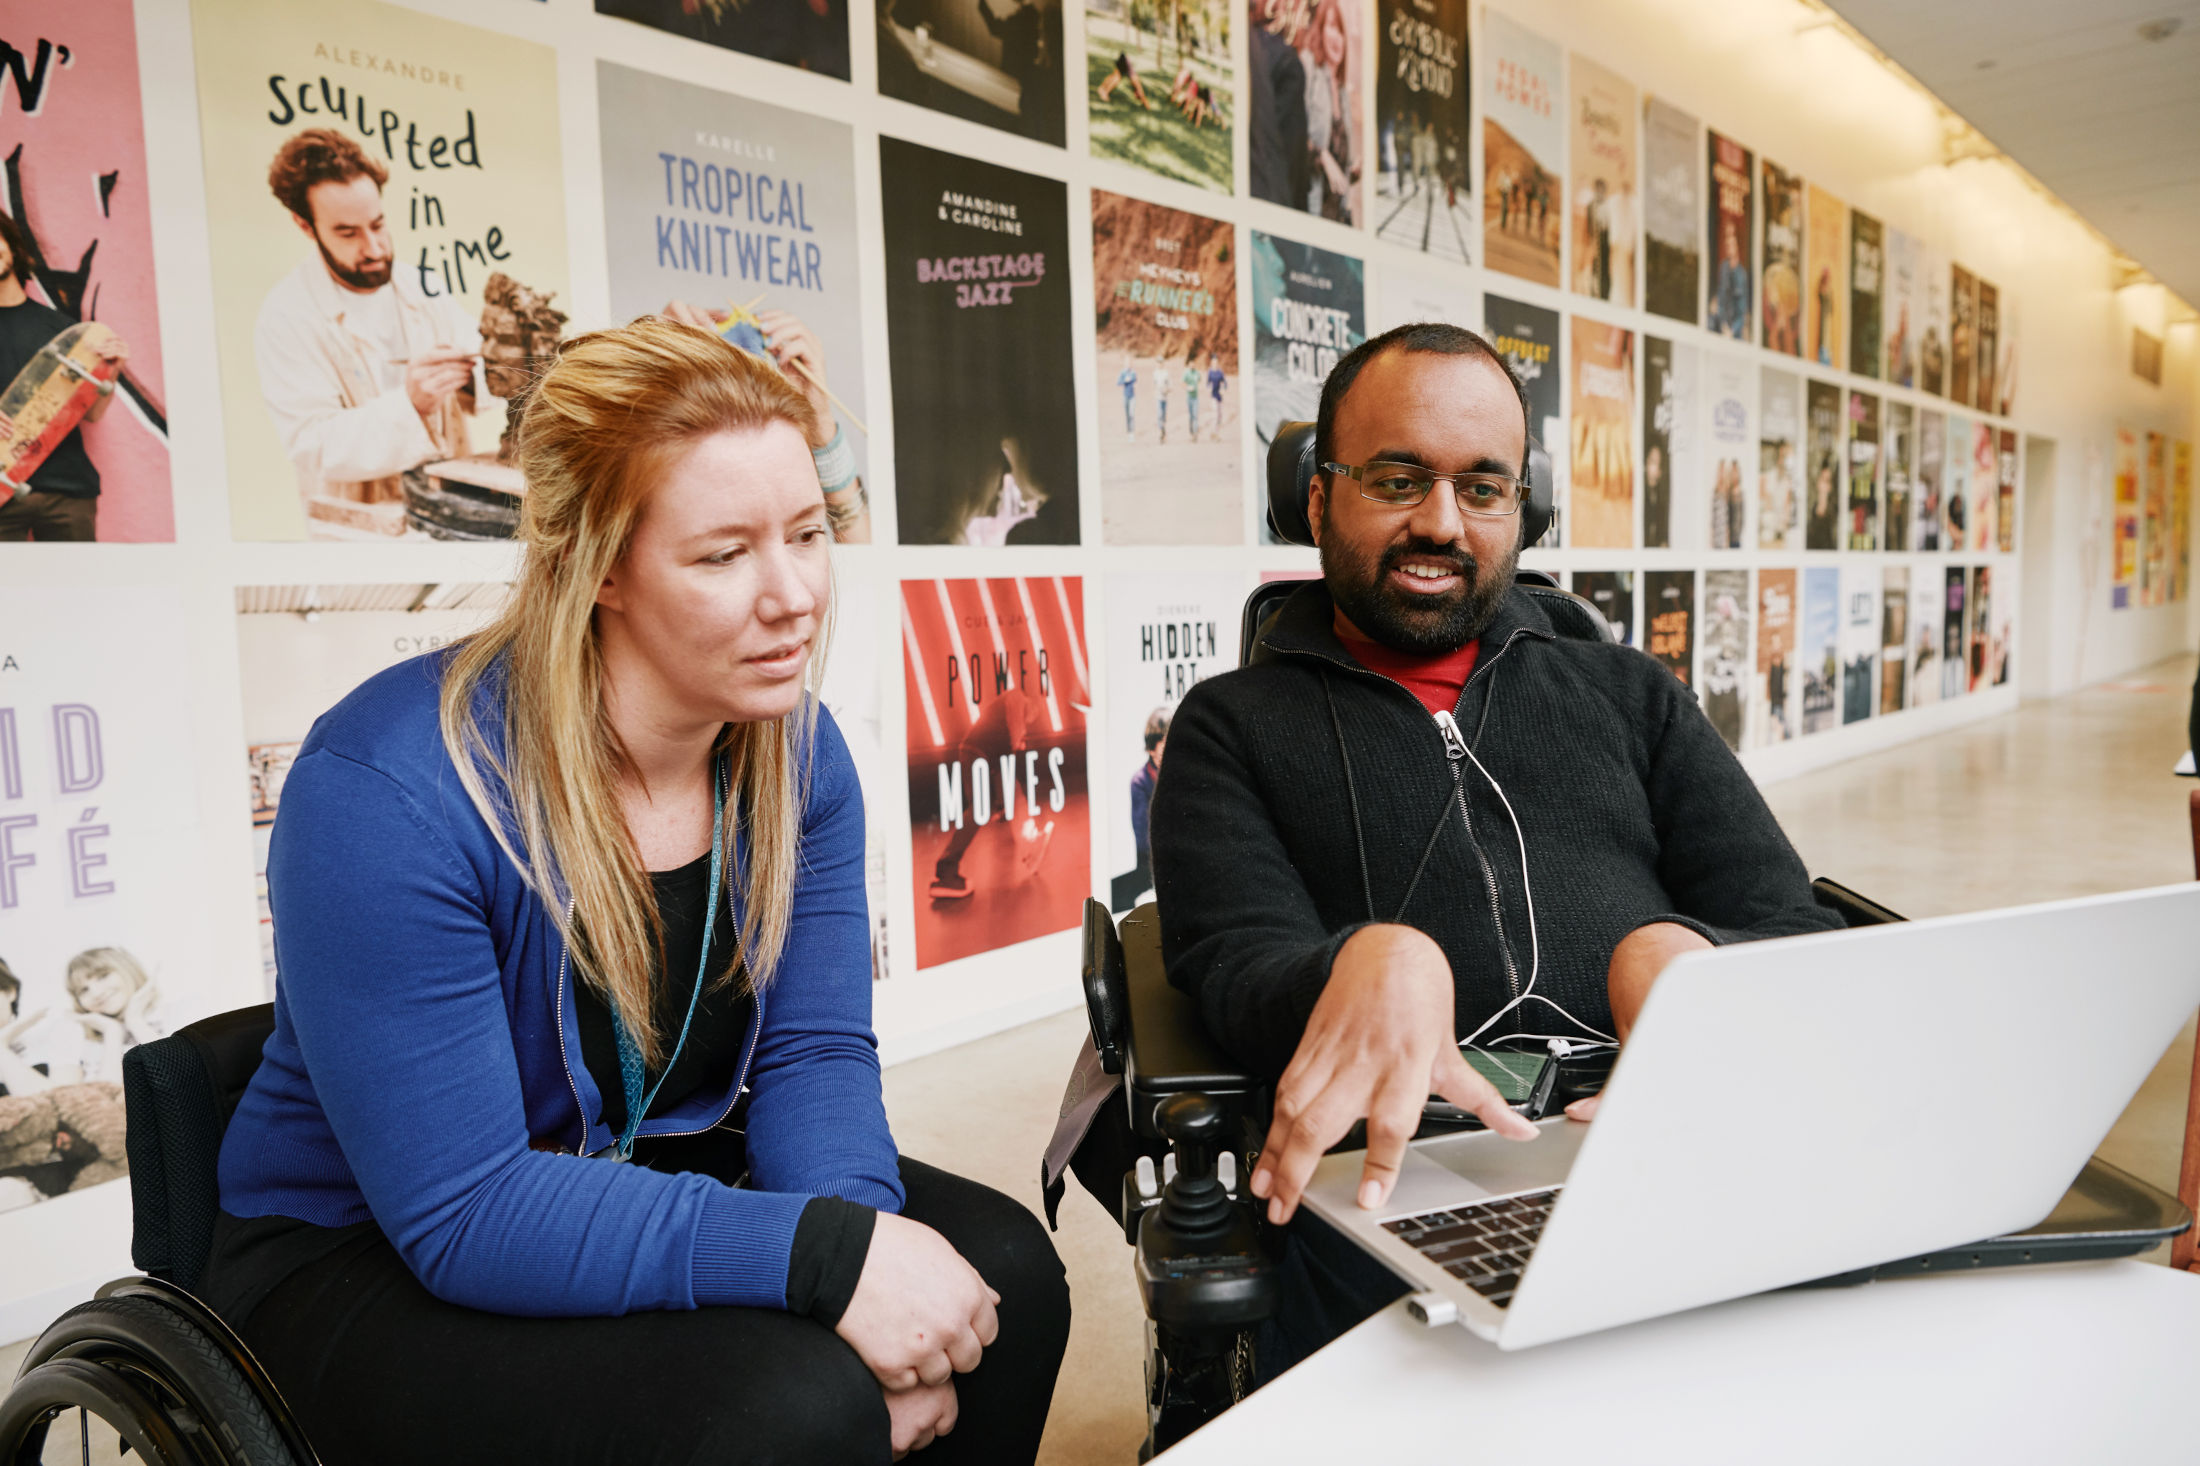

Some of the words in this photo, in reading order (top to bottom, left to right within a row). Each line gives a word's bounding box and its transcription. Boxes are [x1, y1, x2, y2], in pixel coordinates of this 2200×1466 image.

[314, 42, 465, 92] ALEXANDRE
[696, 131, 777, 162] KARELLE
[409, 187, 445, 230] in
[658, 152, 814, 233] TROPICAL
[942, 190, 1018, 220] AMANDINE
[938, 205, 948, 221] &
[951, 209, 1024, 237] CAROLINE
[656, 214, 823, 293] KNITWEAR
[916, 252, 1046, 283] BACKSTAGE
[956, 281, 1014, 309] JAZZ
[1155, 311, 1190, 331] CLUB
[1271, 296, 1352, 351] CONCRETE
[1141, 621, 1216, 662] HIDDEN
[948, 648, 1049, 708] POWER
[938, 746, 1065, 833] MOVES
